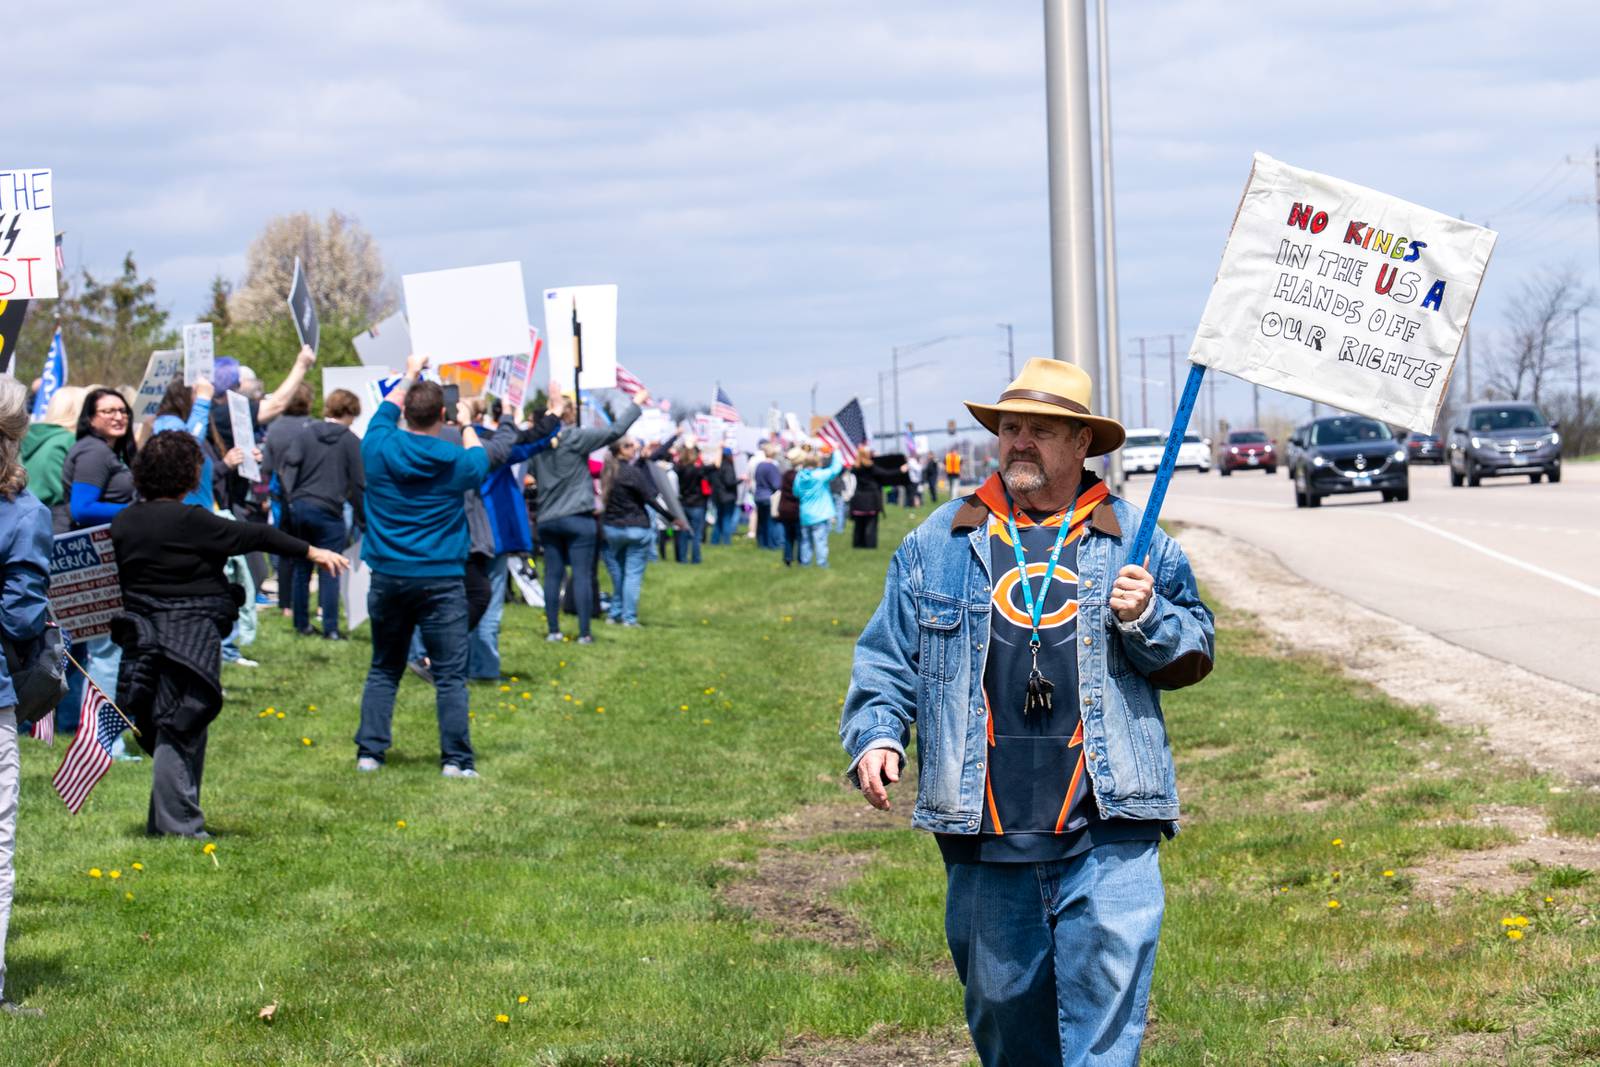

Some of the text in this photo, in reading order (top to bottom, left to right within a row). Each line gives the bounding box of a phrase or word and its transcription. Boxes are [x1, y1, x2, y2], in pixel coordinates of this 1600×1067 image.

[1287, 202, 1428, 263] NO KINGS
[1274, 273, 1421, 343] HANDS OFF
[1275, 239, 1446, 312] IN THE USA
[1261, 311, 1442, 389] OUR RIGHTS
[48, 552, 97, 572] MERICA
[68, 537, 91, 551] OUR
